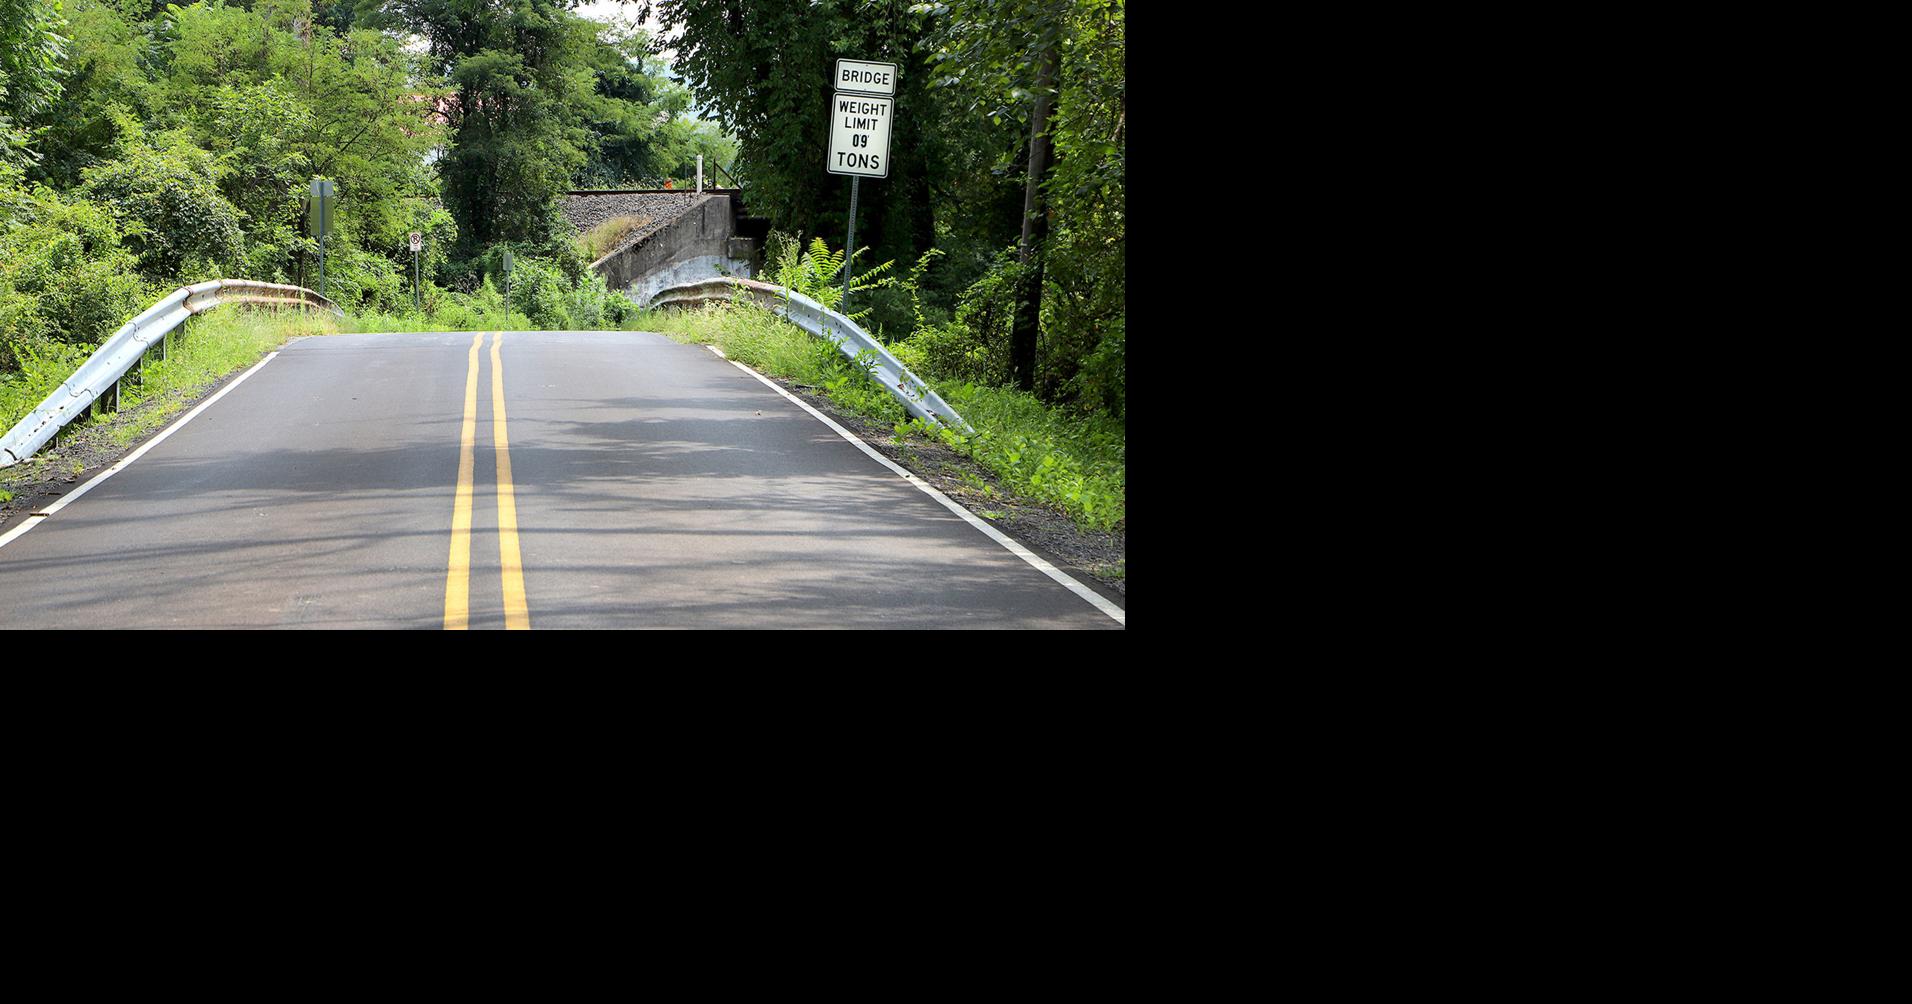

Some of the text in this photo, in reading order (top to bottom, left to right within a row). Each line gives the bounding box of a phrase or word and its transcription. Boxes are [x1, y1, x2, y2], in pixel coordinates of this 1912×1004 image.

[842, 69, 889, 85] BRIDGE
[840, 100, 887, 116] WEIGHT
[845, 116, 878, 131] LIMIT
[837, 152, 879, 169] TONS
